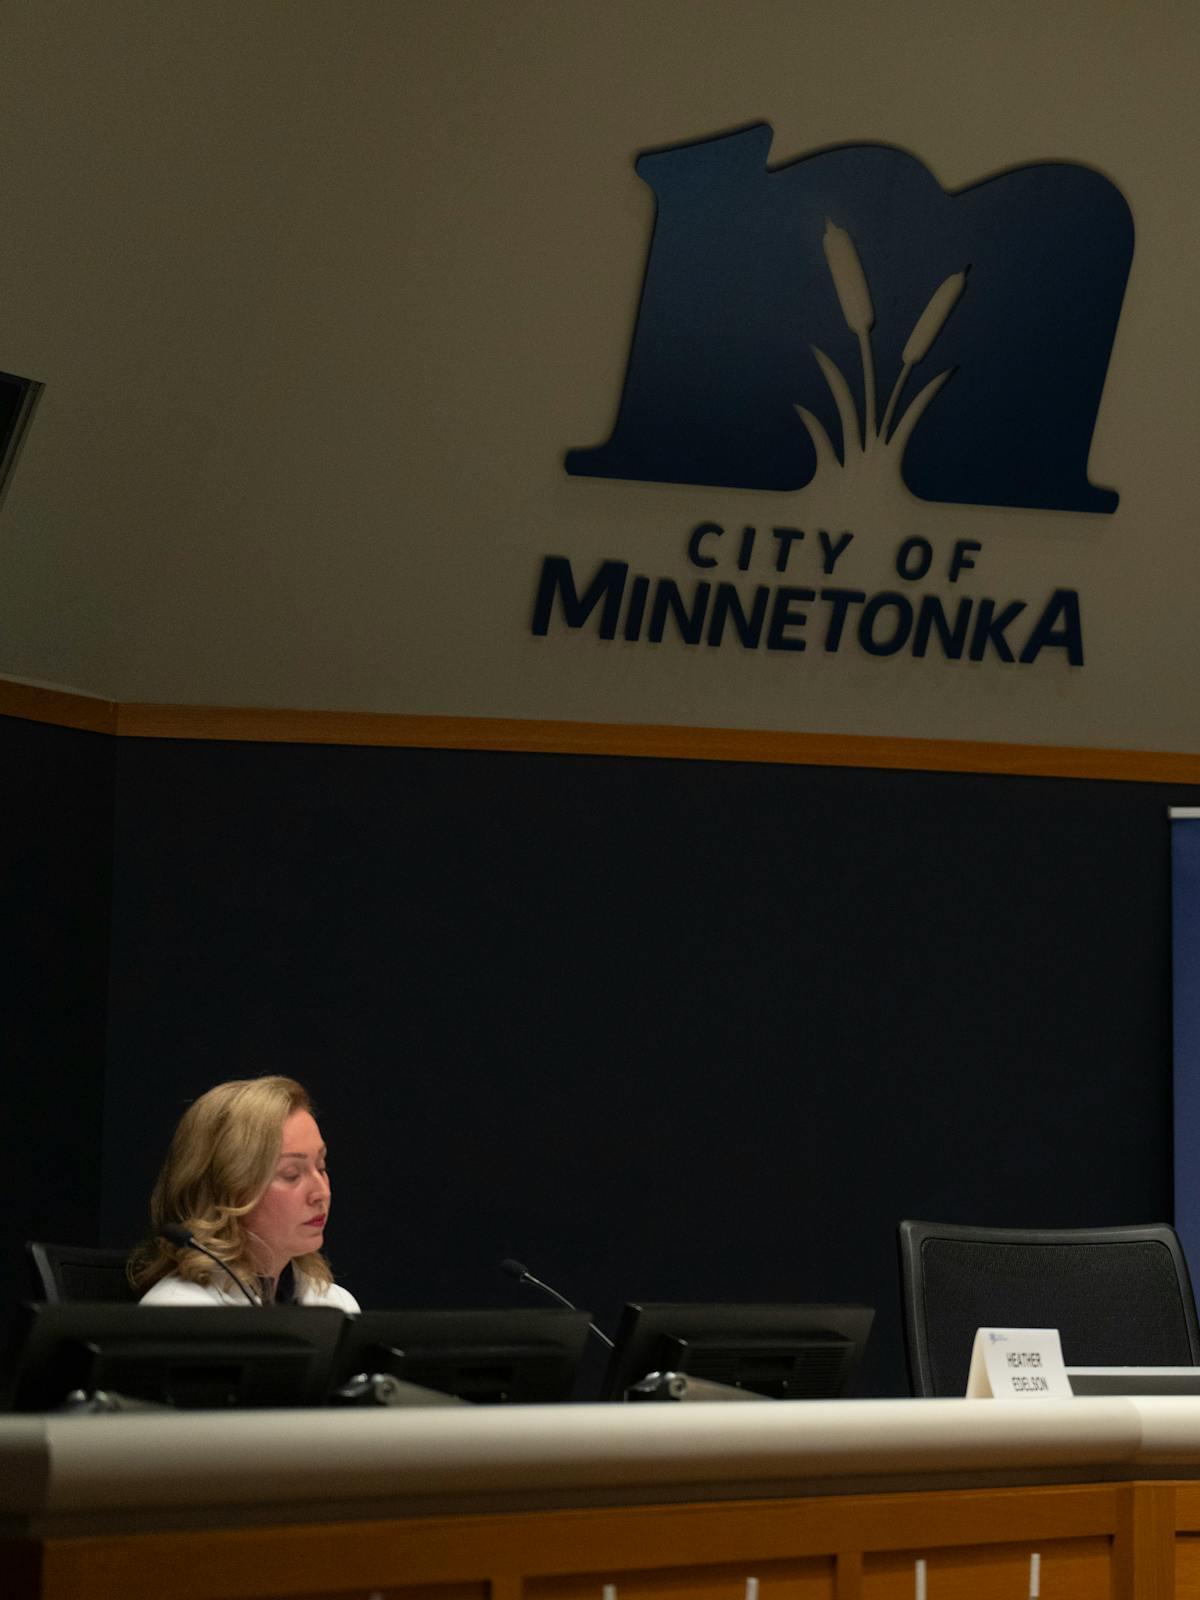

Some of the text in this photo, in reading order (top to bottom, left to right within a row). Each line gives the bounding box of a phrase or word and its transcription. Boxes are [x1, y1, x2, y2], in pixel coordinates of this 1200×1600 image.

[687, 522, 982, 583] CITY OF
[530, 555, 1084, 666] MINNETONKA
[1007, 1352, 1042, 1368] HEATHER
